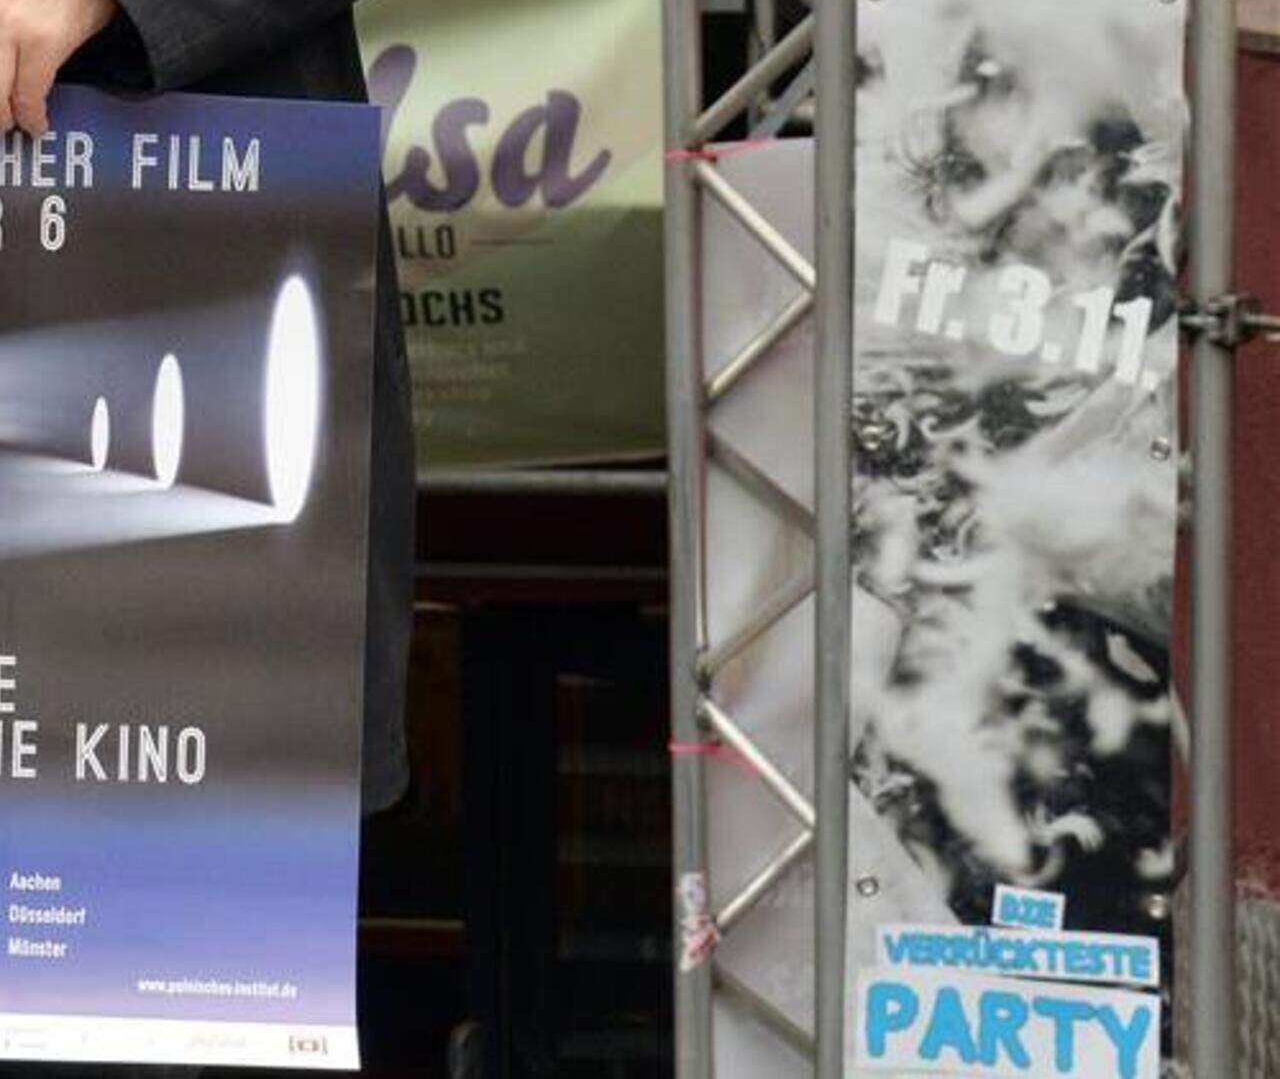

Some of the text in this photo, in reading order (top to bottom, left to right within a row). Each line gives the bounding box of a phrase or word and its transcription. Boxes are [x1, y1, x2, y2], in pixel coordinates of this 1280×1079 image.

[131, 132, 262, 194] FILM
[40, 194, 68, 252] 6
[875, 238, 967, 341] Fr.
[74, 721, 207, 785] KINO
[9, 871, 62, 892] Aachen
[1000, 892, 1059, 929] DIE
[865, 980, 1152, 1079] PARTY
